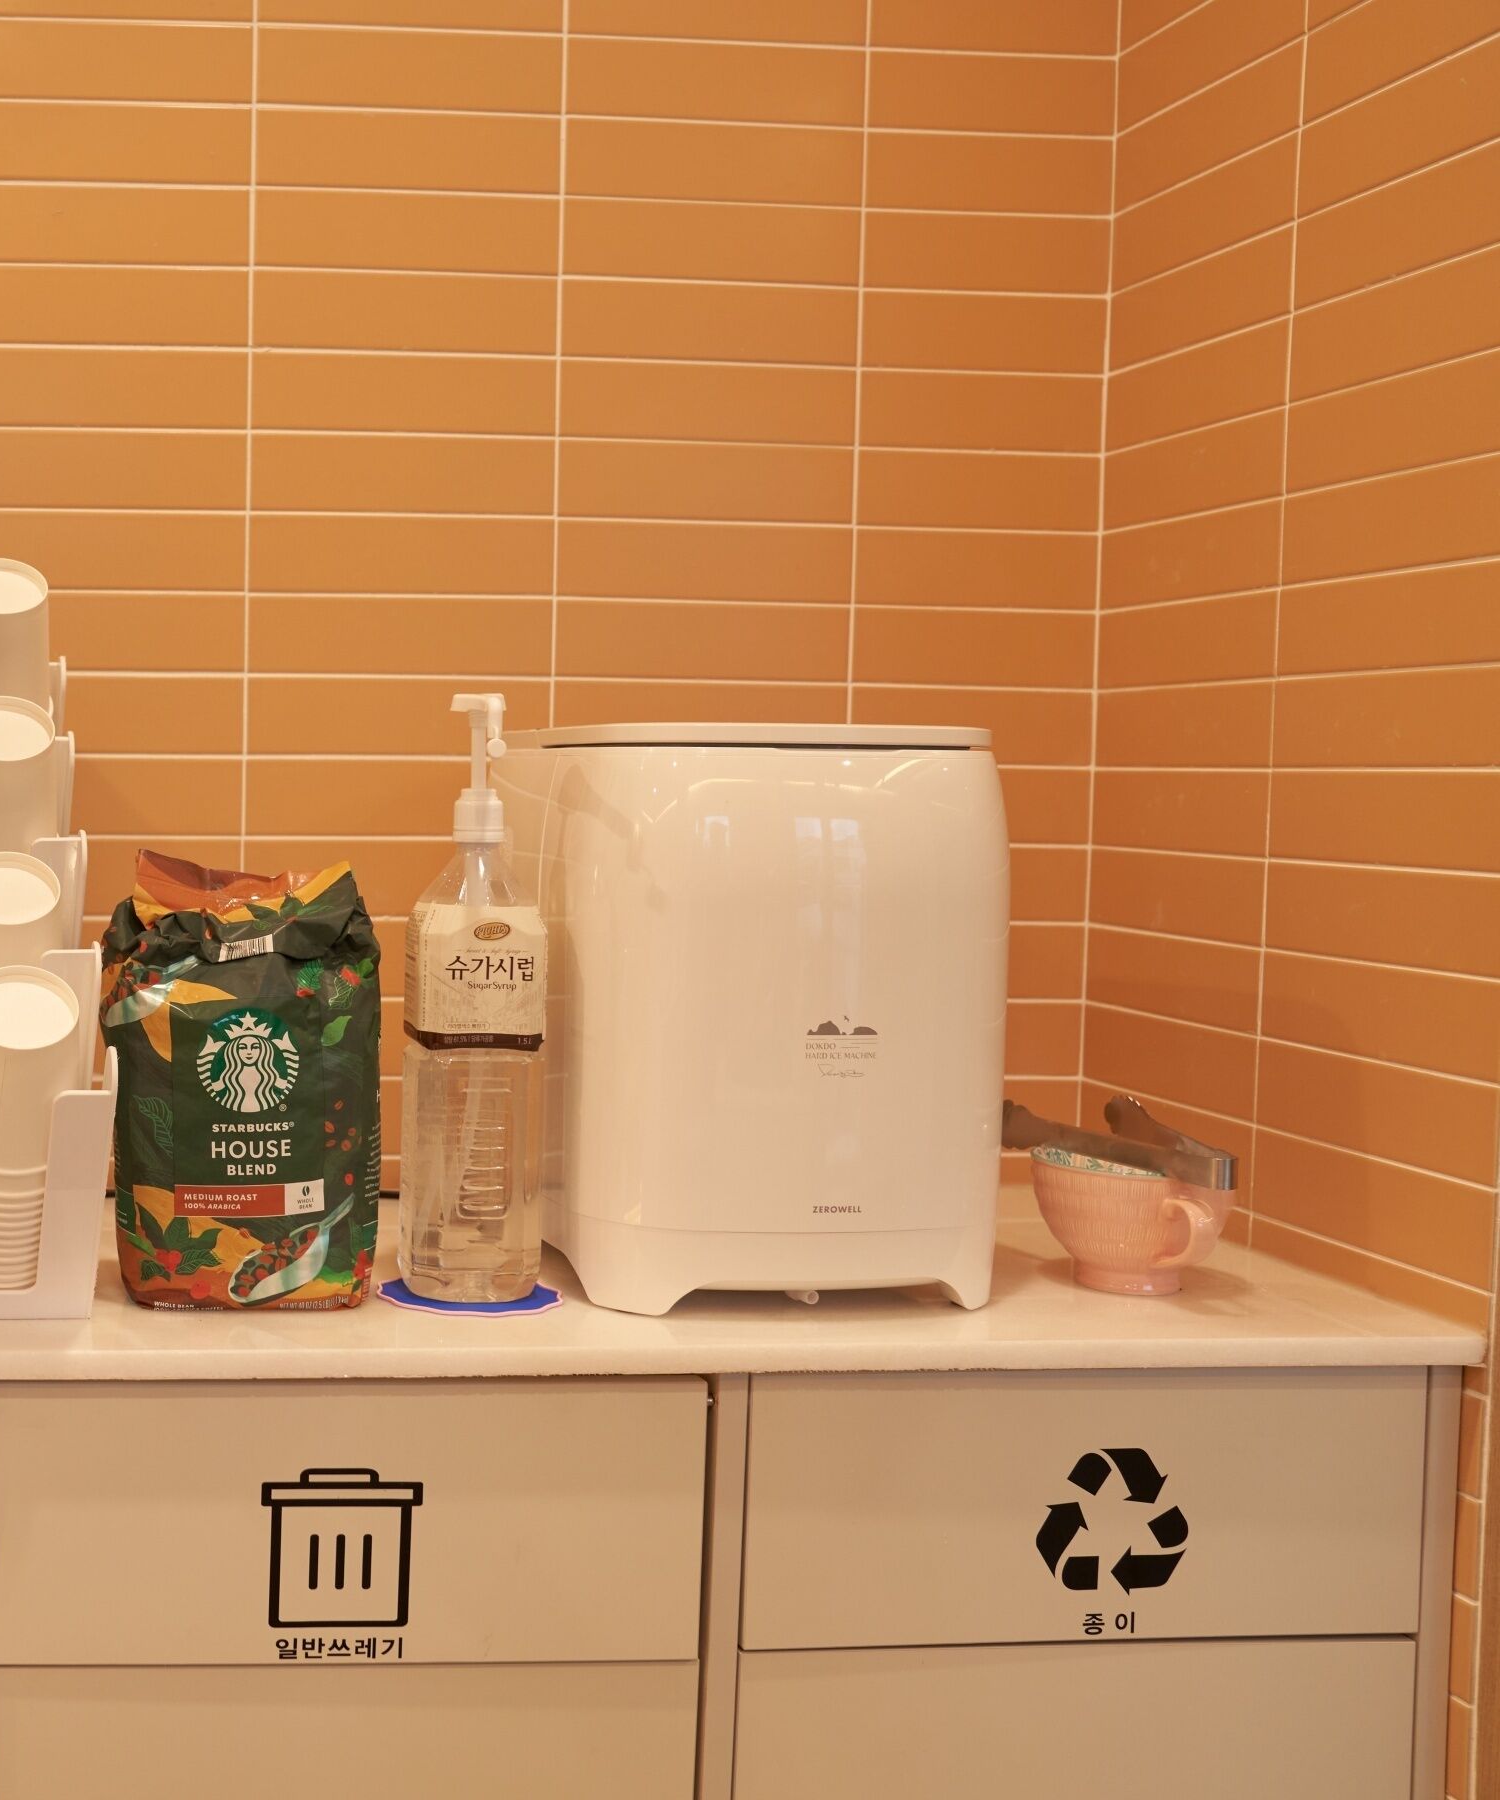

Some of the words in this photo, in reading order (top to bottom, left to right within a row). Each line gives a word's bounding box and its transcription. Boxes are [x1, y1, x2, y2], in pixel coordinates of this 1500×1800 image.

[445, 956, 534, 981] 슈가시럽
[211, 1139, 292, 1159] HOUSE
[227, 1163, 277, 1176] BLEND
[184, 1193, 223, 1201] MEDIUM
[813, 1205, 862, 1214] ZEROWELL
[275, 1637, 404, 1660] 일반쓰레기
